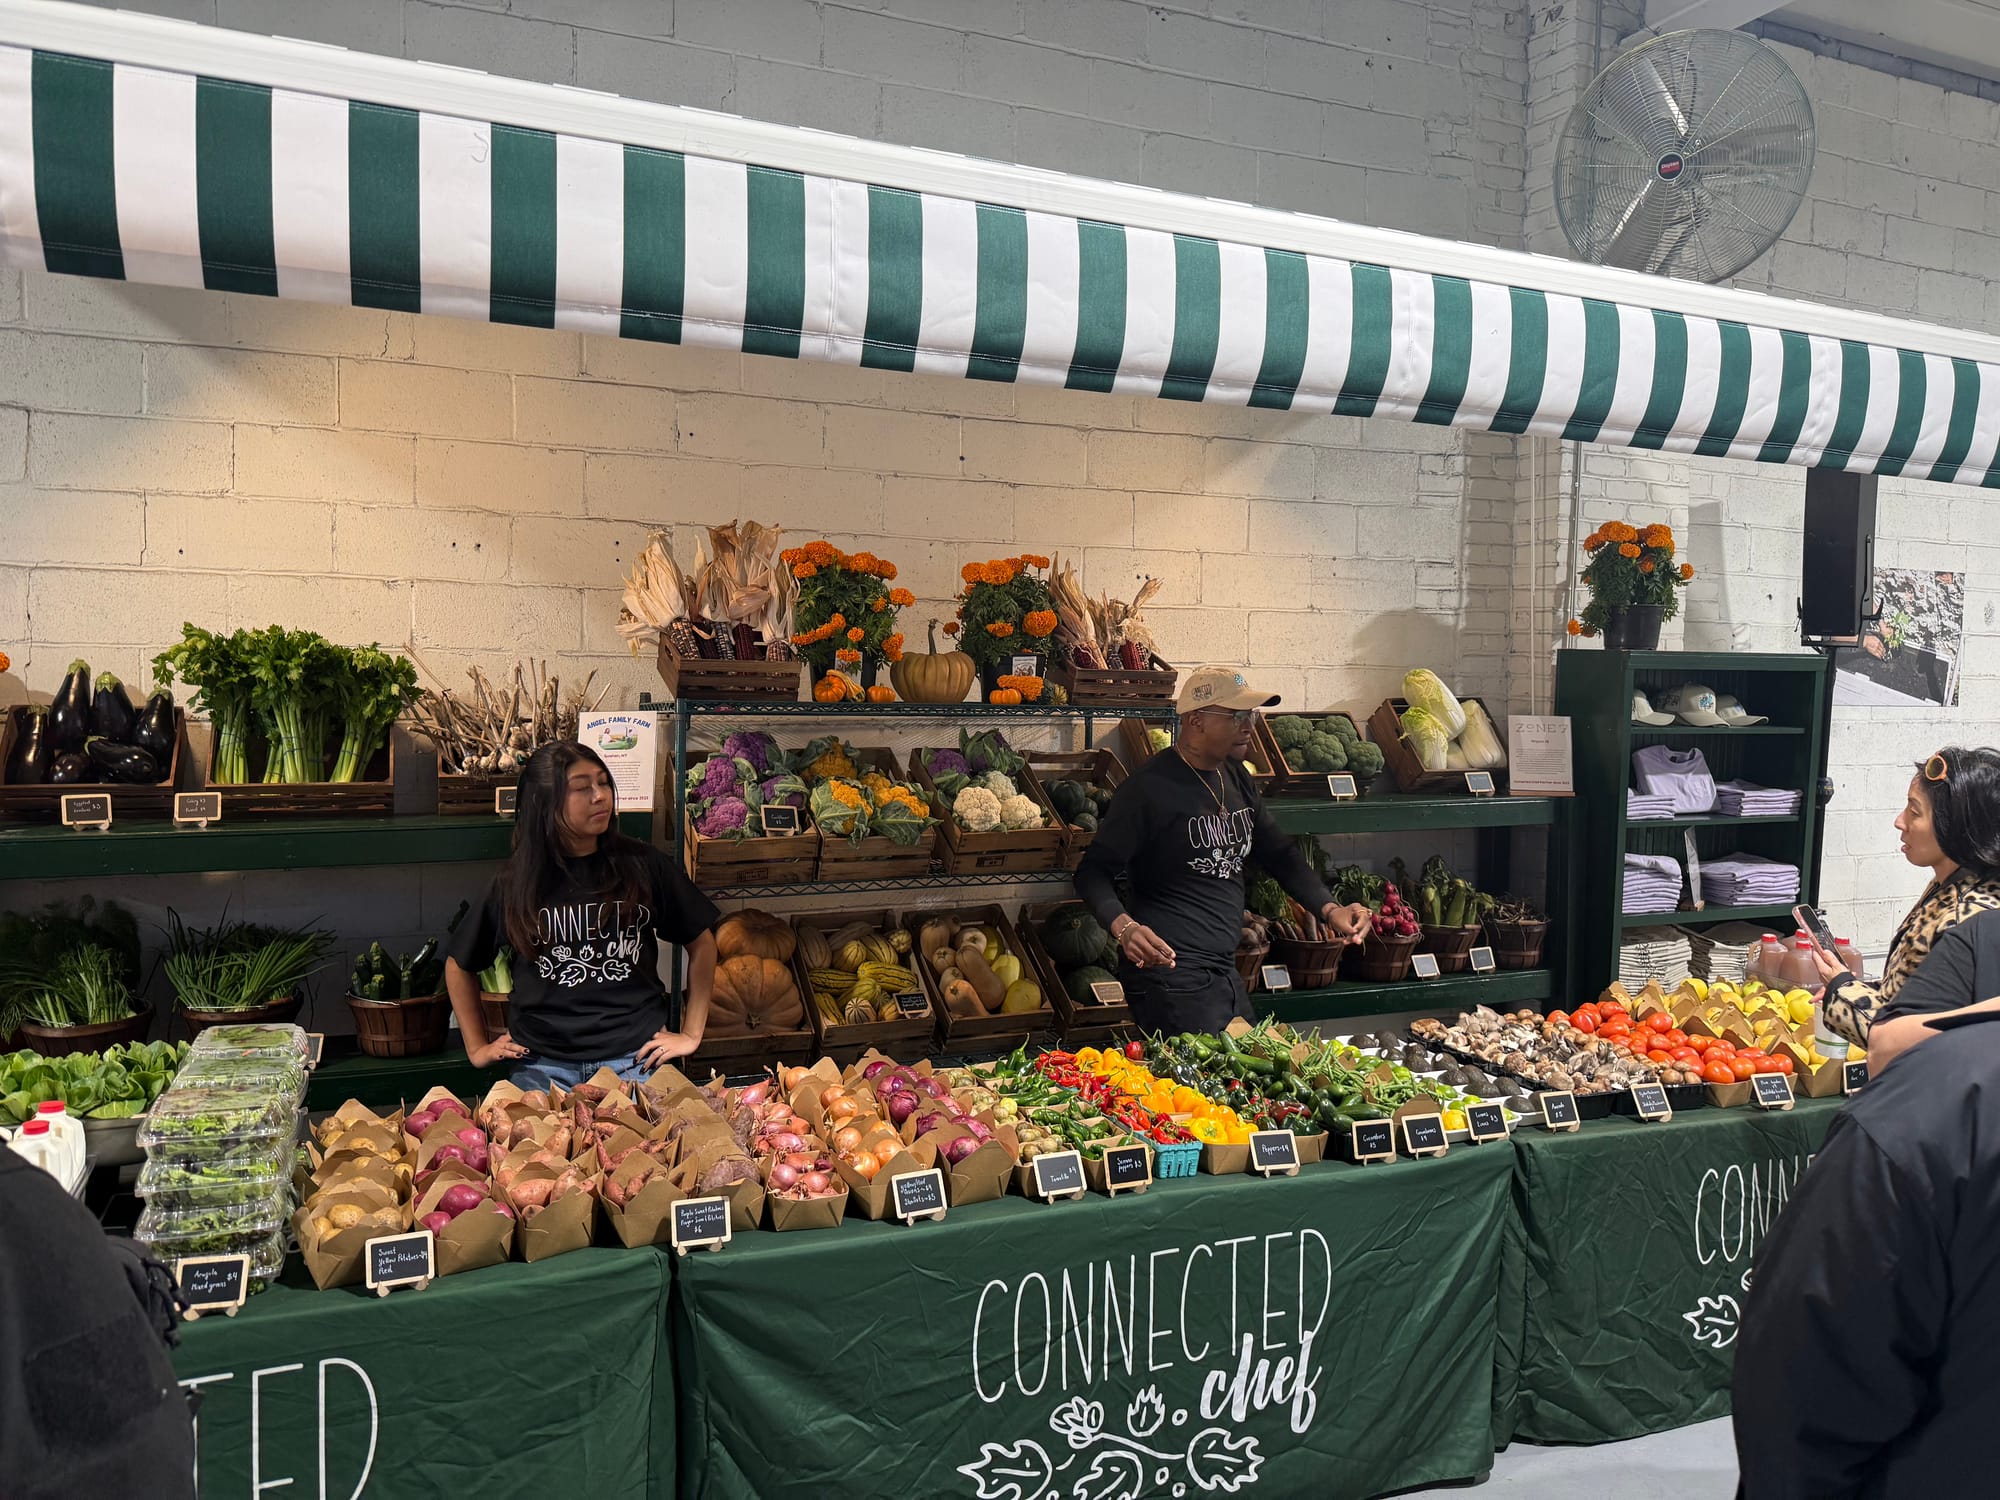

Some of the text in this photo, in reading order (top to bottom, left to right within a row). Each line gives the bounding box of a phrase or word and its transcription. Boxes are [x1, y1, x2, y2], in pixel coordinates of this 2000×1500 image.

[587, 716, 651, 730] ANGEL FAMILY FARM
[607, 931, 643, 965] chef
[226, 1271, 238, 1281] $4
[973, 1229, 1332, 1402] CONNECTED
[1200, 1331, 1322, 1433] chef
